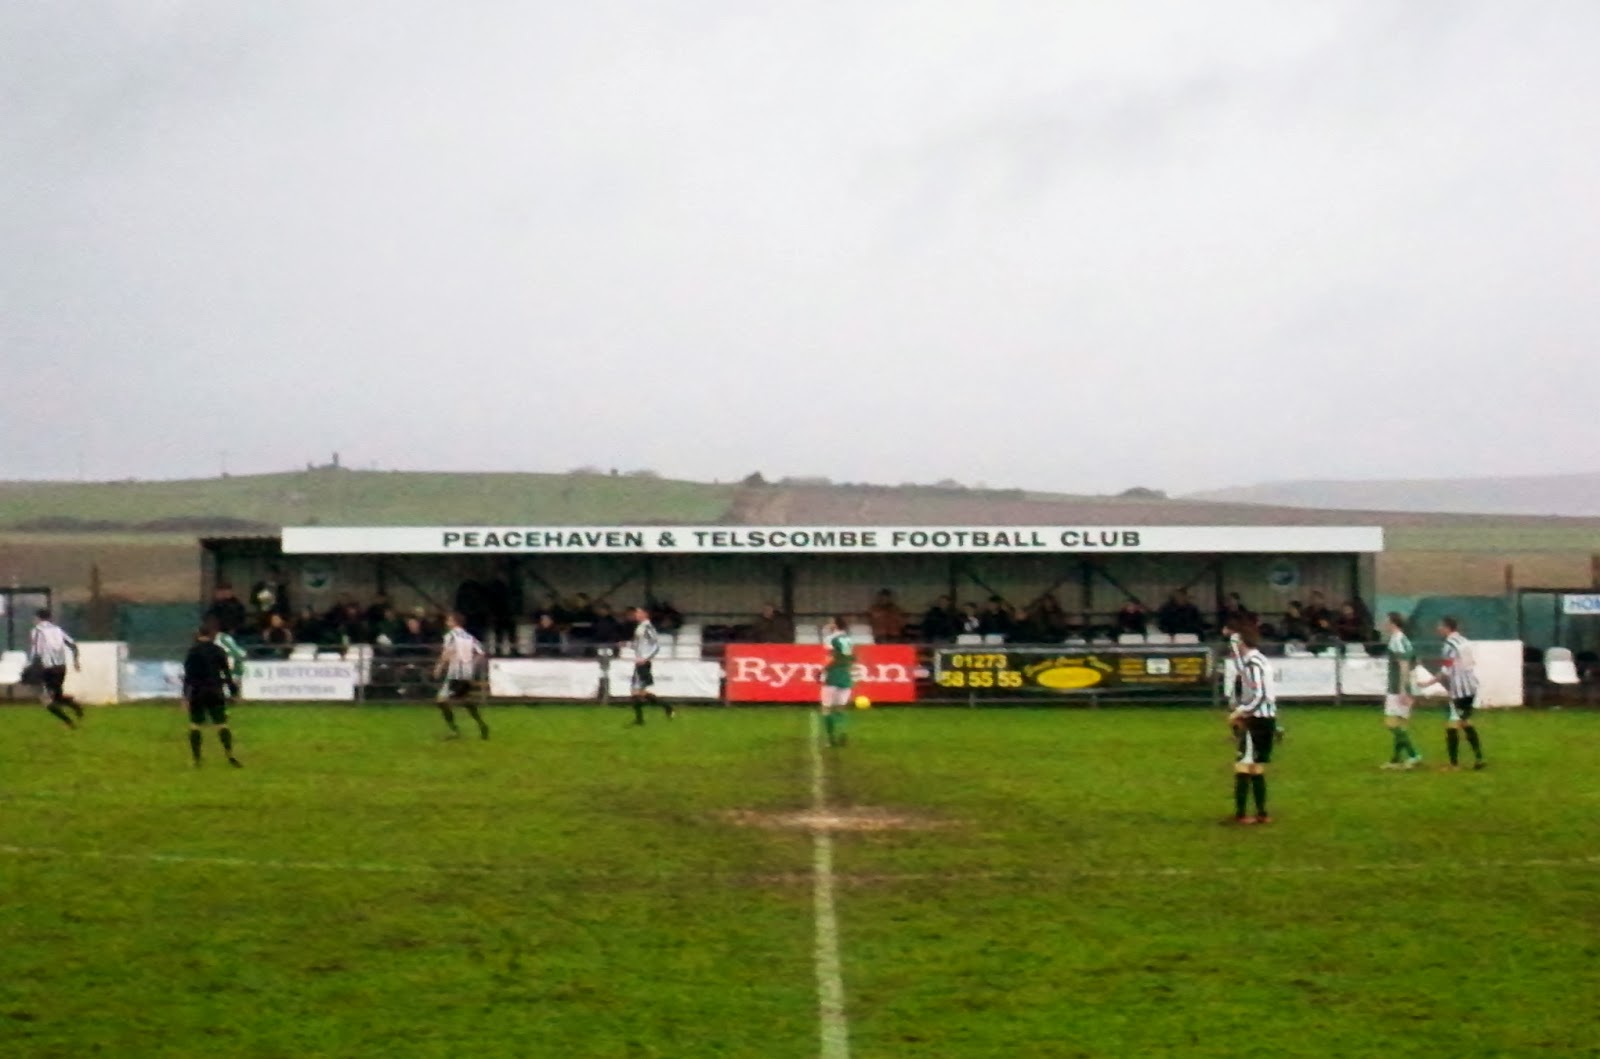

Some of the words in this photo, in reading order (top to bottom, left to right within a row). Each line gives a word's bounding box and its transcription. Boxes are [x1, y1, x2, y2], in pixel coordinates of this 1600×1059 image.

[443, 531, 643, 547] PEACEHAVEN
[658, 531, 677, 547] &
[693, 531, 877, 547] TELSCOMBE
[892, 531, 1047, 547] FOOTBALL
[1060, 531, 1141, 547] CLUB
[952, 654, 1007, 668] 01273
[968, 671, 993, 687] 55
[998, 671, 1022, 687] 55
